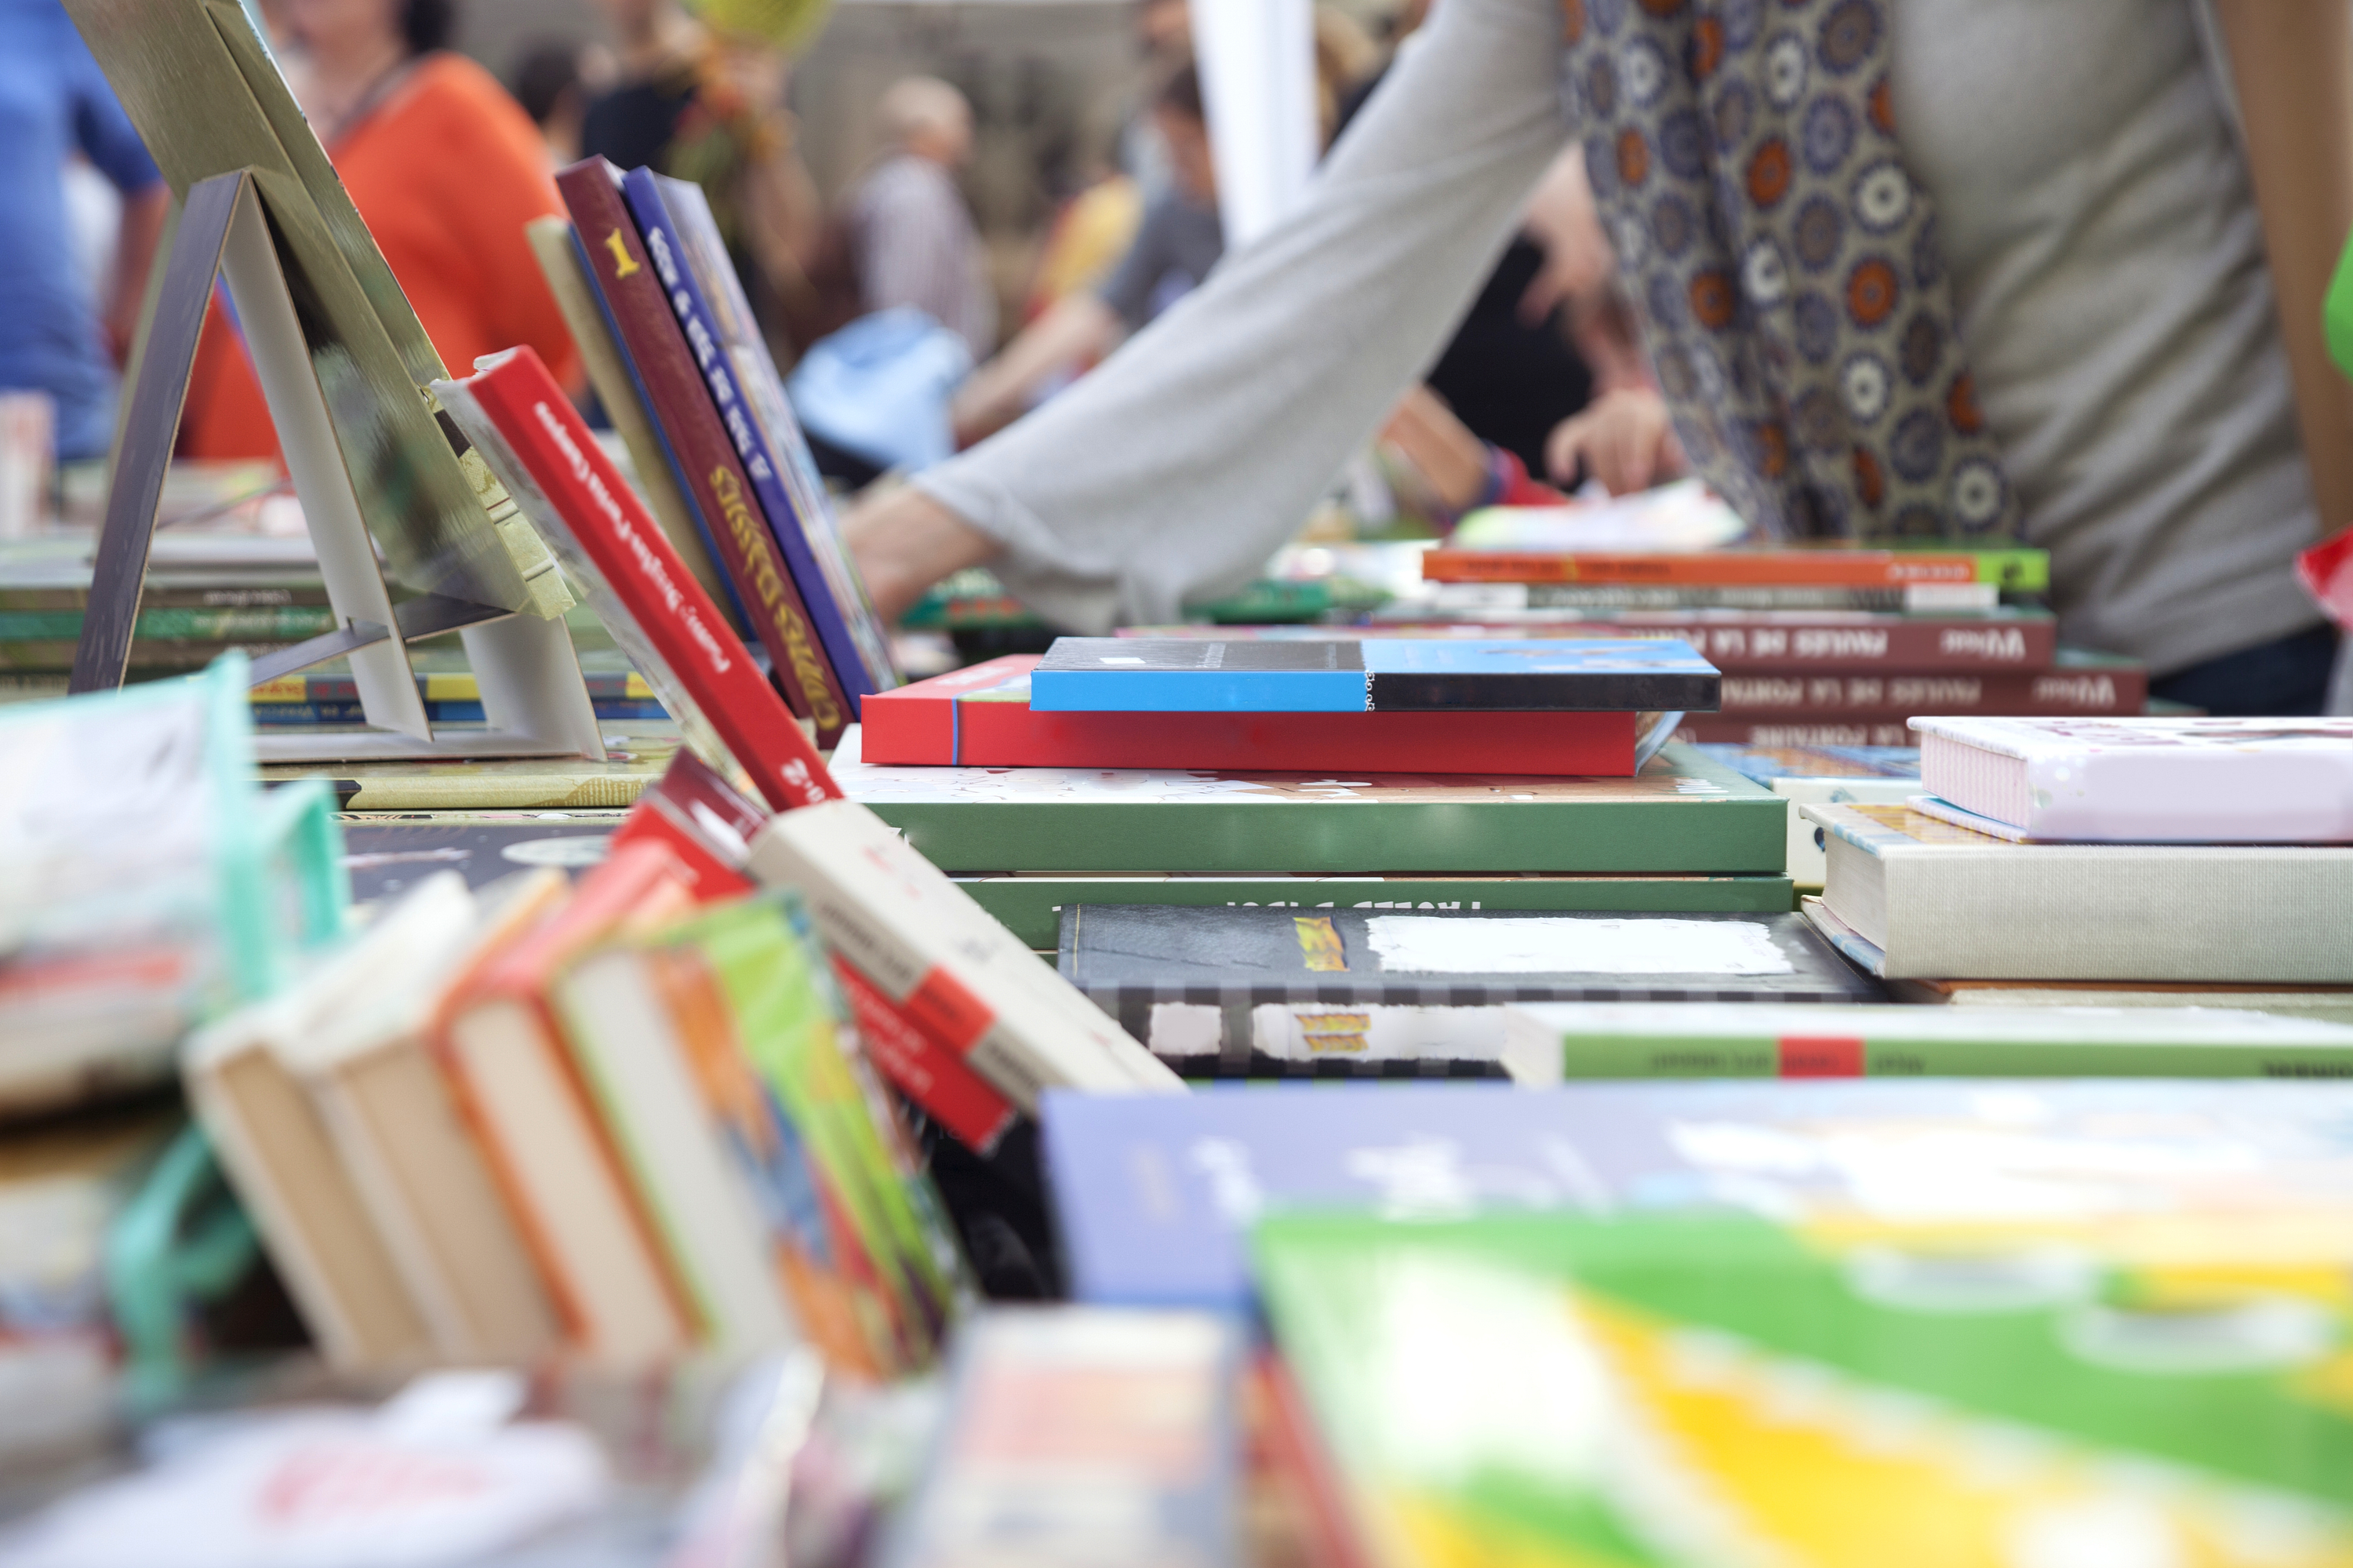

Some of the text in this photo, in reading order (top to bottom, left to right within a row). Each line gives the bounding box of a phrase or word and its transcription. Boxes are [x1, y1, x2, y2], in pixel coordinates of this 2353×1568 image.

[605, 227, 640, 279] 1
[1712, 630, 1747, 656] LA
[1751, 630, 1787, 658] DE
[774, 602, 842, 731] CONTES
[1809, 676, 1843, 703] LA
[1848, 676, 1884, 704] DE
